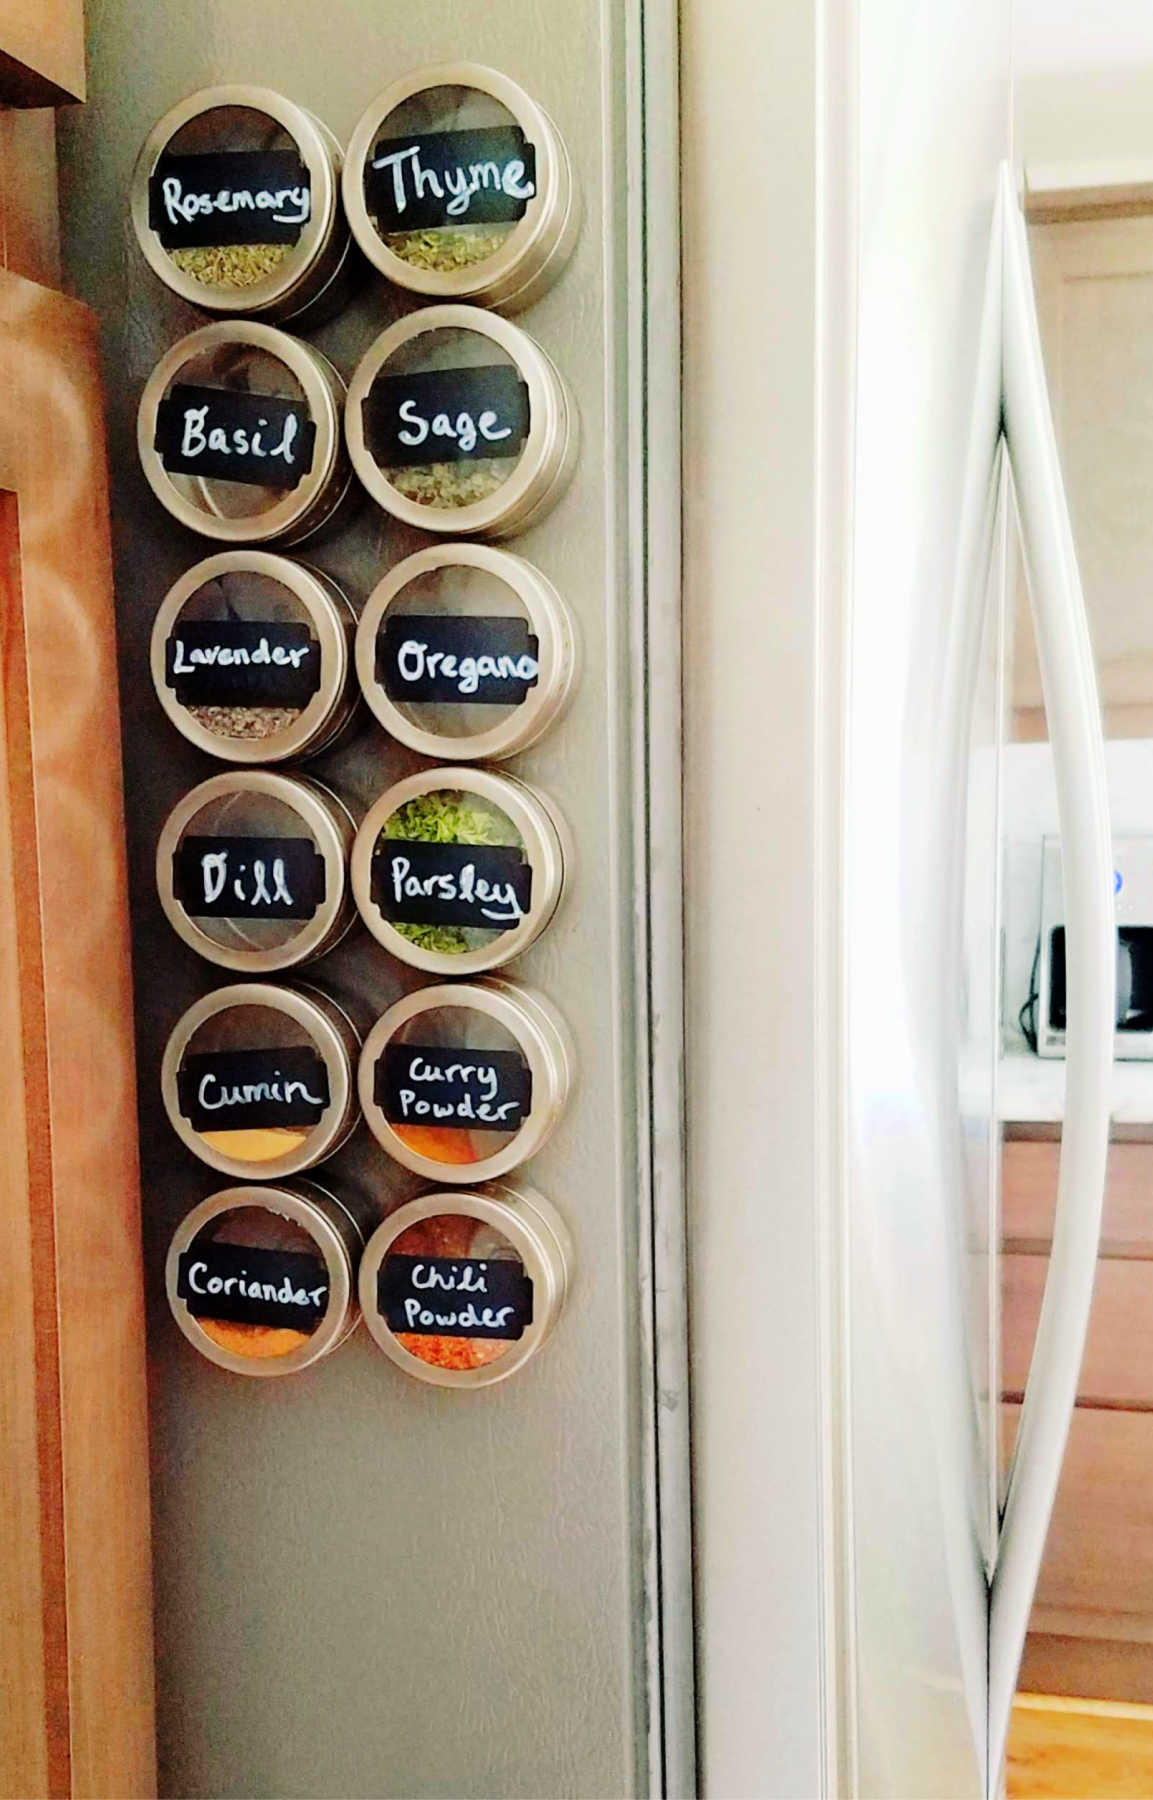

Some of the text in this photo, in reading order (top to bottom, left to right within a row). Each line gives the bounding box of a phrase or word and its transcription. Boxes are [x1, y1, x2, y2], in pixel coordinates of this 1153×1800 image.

[162, 178, 310, 225] Rosemary
[372, 145, 535, 214] Thyme
[180, 405, 298, 463] Basil
[398, 400, 512, 451] Sage
[173, 638, 310, 674] Lavender
[398, 640, 539, 693] Oregano
[201, 852, 293, 905] Dill
[391, 856, 524, 919] Parsley
[199, 1070, 323, 1109] Cumin
[409, 1057, 498, 1101] Curry
[399, 1089, 520, 1122] Powder
[188, 1261, 327, 1307] Coriander
[411, 1263, 488, 1293] Chili
[404, 1299, 515, 1328] Powder
